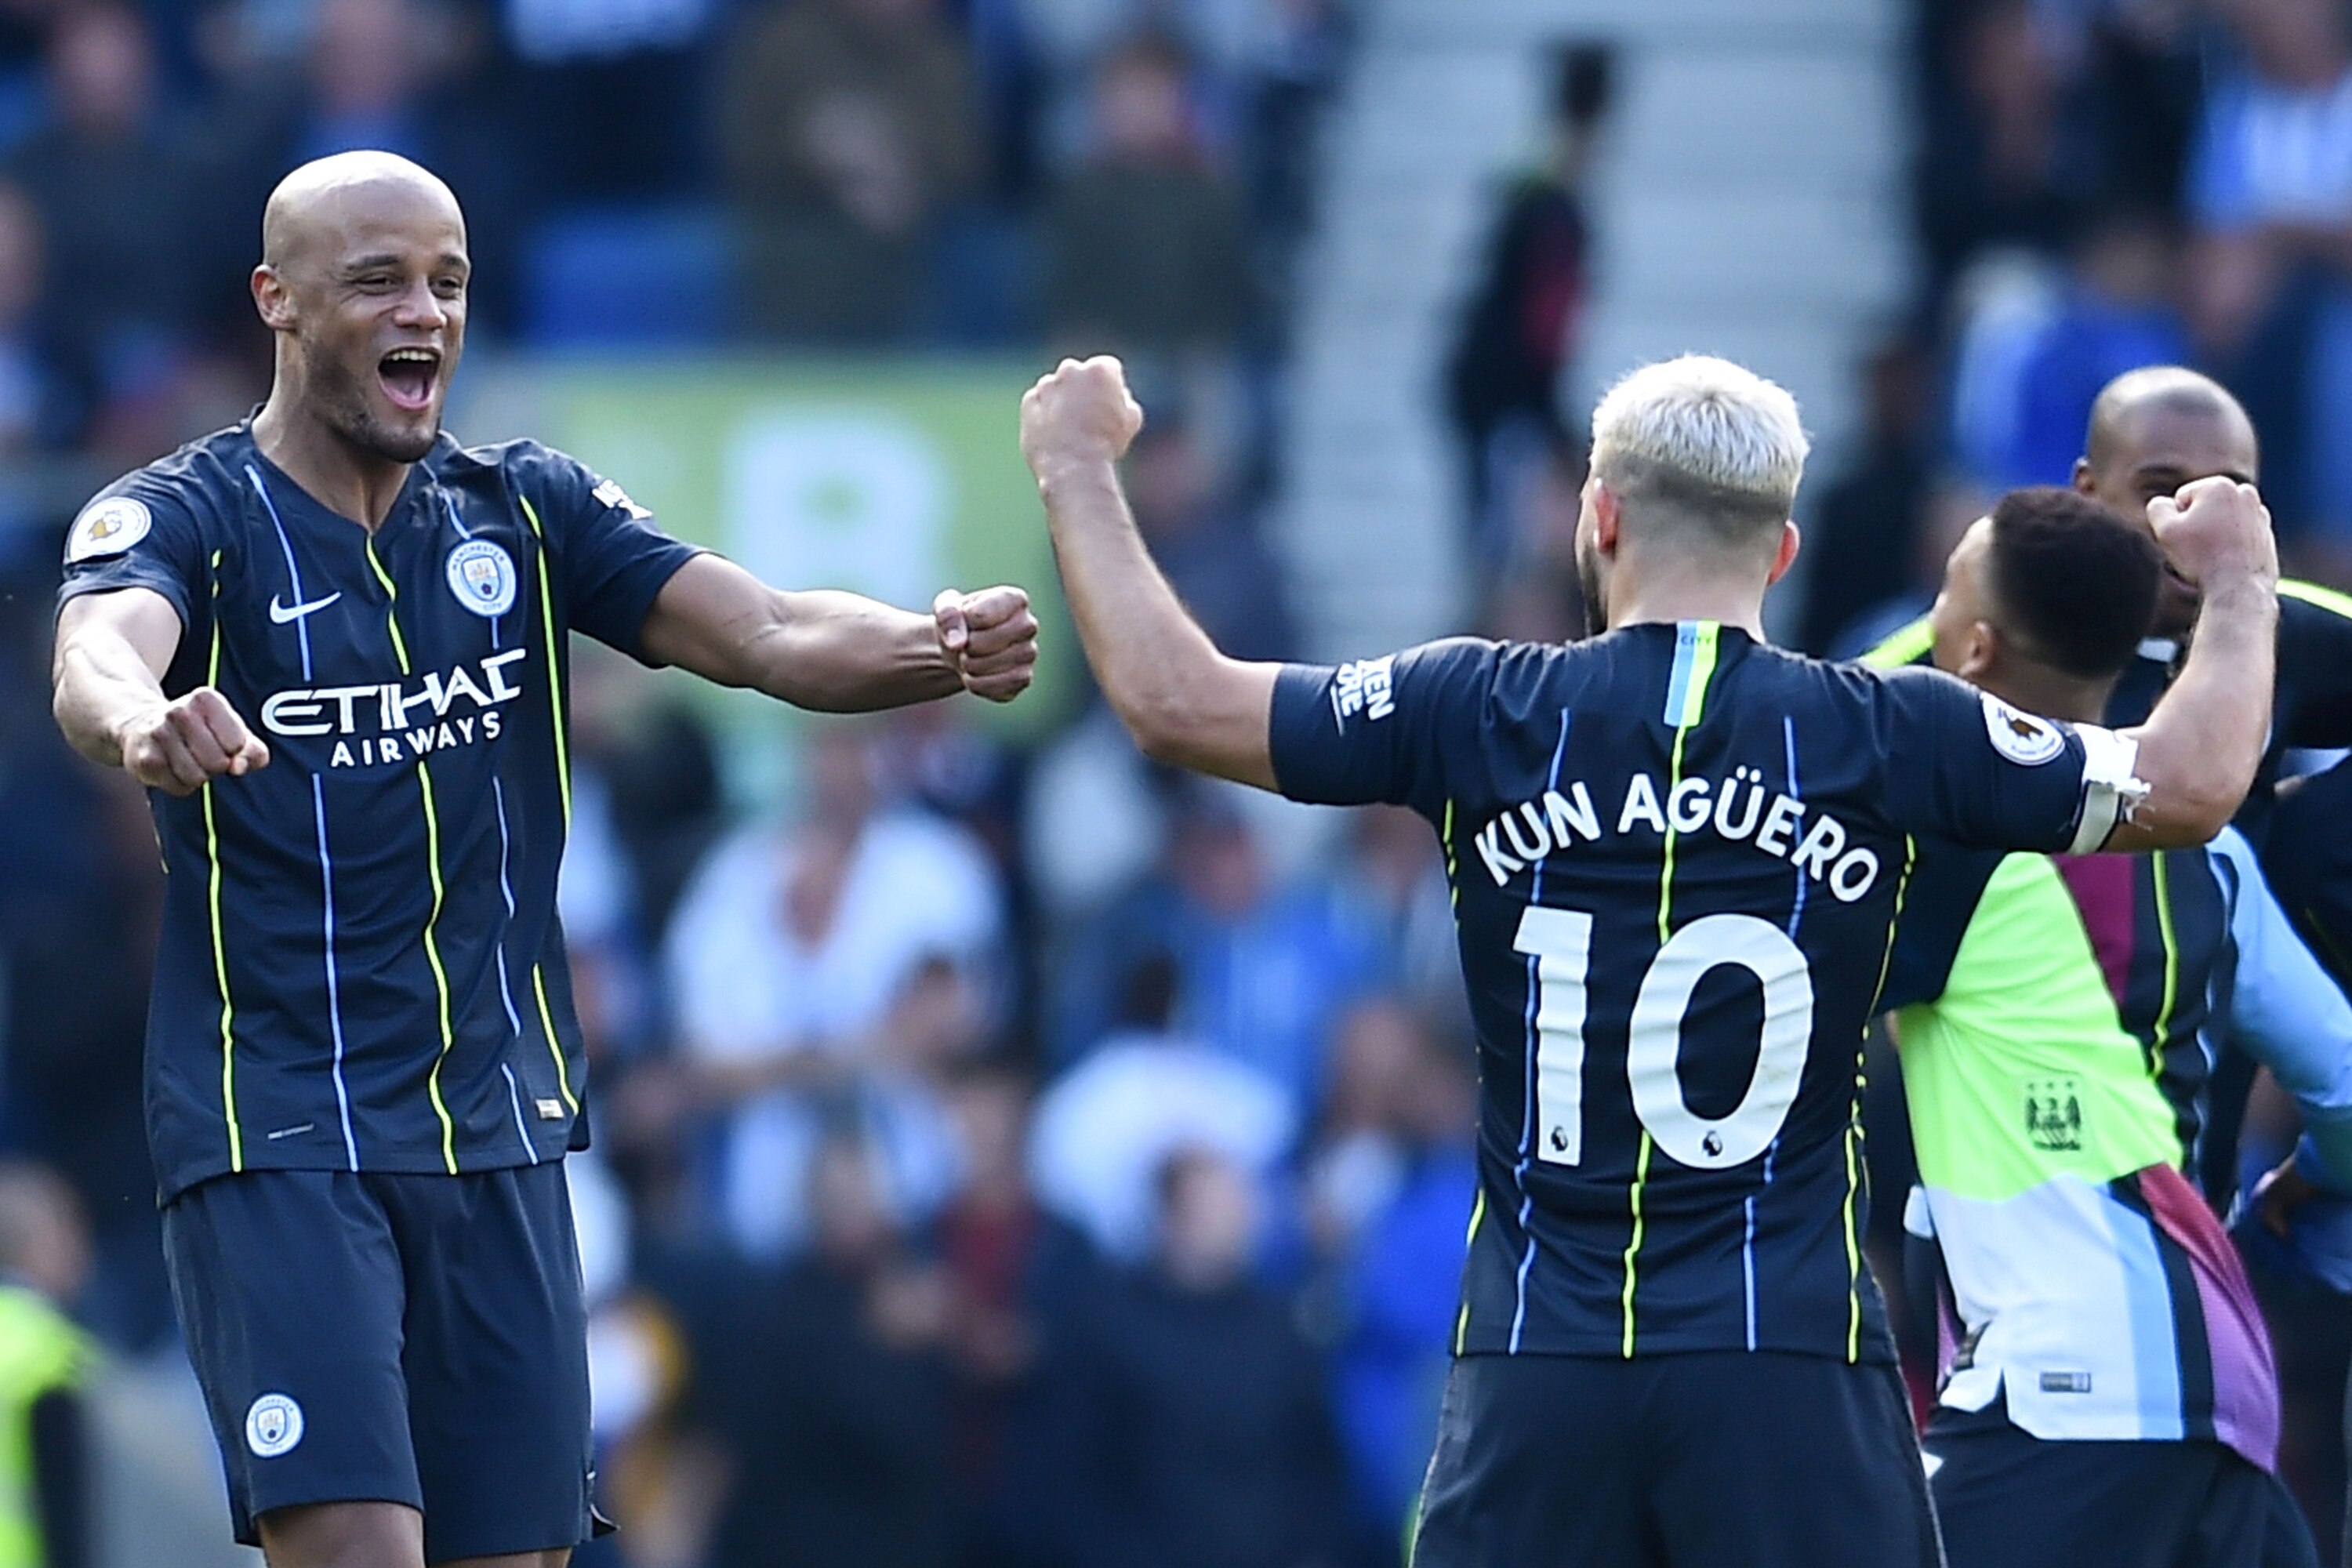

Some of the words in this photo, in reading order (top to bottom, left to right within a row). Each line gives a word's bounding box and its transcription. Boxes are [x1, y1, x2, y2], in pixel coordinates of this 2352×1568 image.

[330, 711, 501, 768] AIRWAYS
[1474, 781, 1602, 887] KUN
[1617, 765, 1879, 903] AGÜERO
[1512, 906, 1814, 1169] 10
